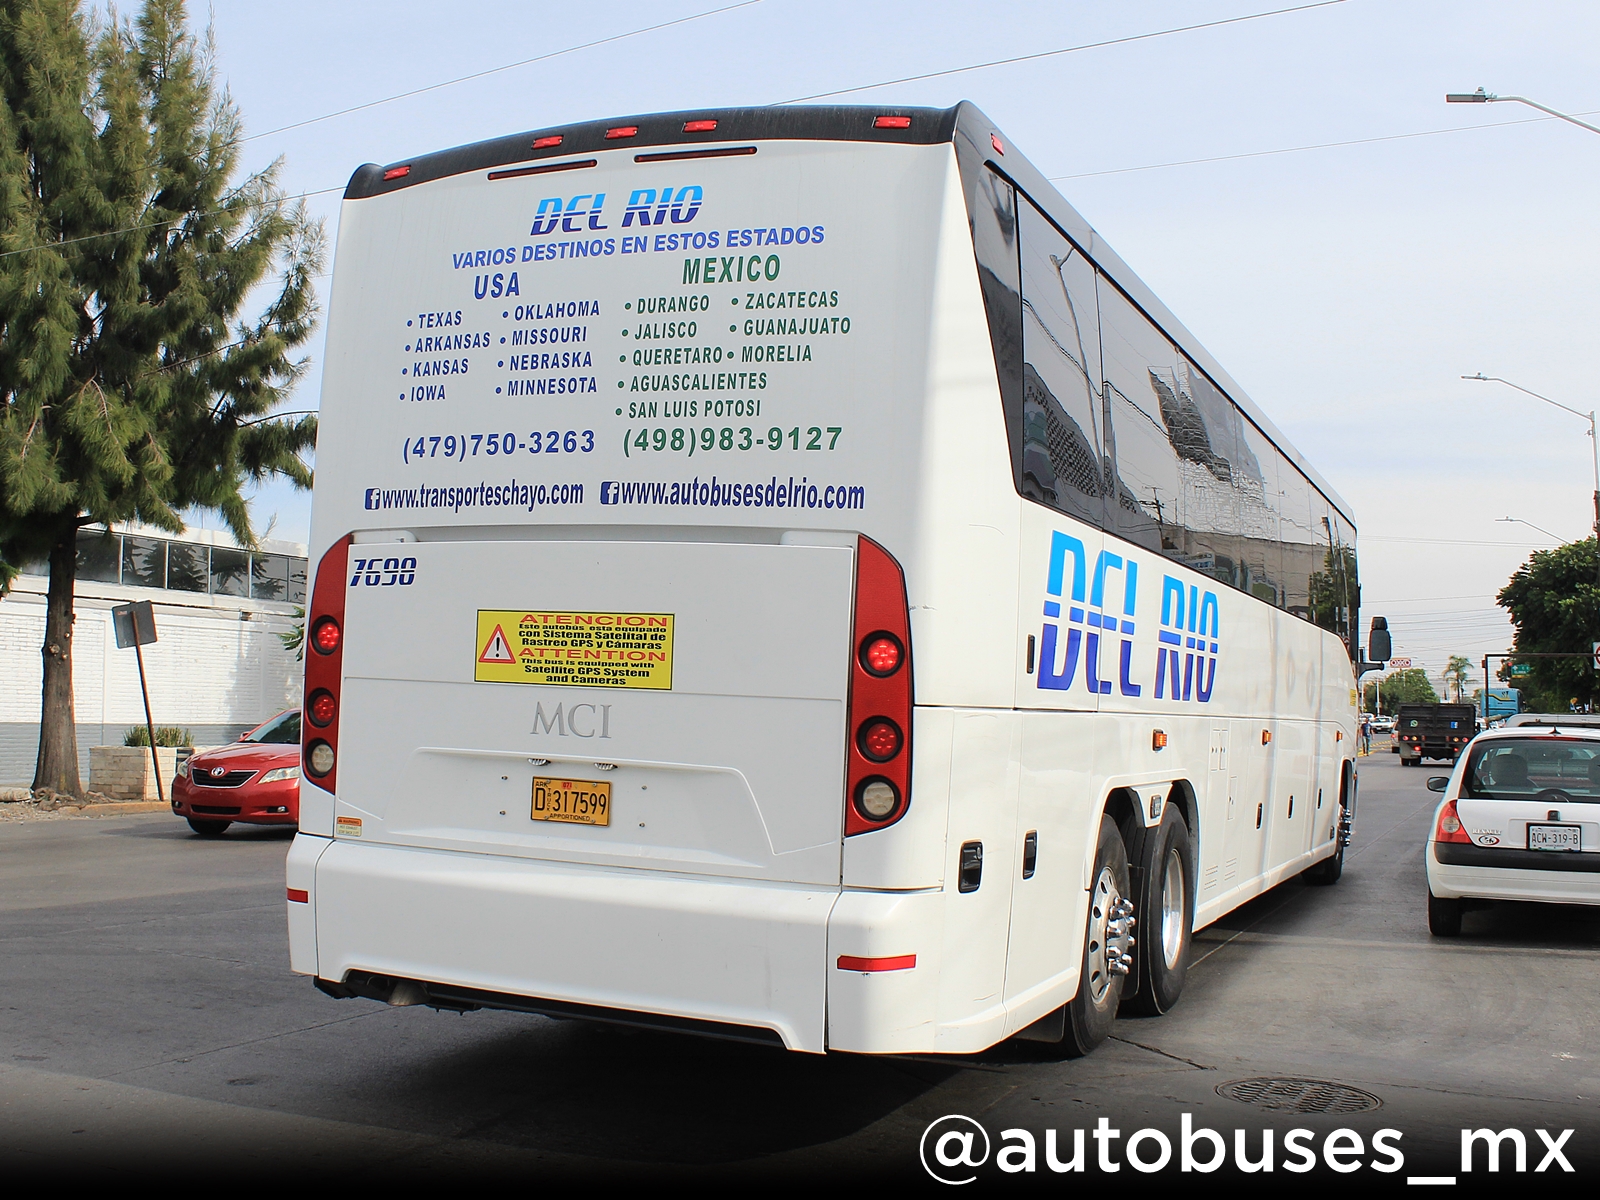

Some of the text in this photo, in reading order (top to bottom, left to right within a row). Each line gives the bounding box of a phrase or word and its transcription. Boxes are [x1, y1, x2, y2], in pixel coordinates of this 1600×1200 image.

[530, 185, 703, 236] DEL RIO
[452, 226, 825, 269] VARIOS DESTINOS EN ESTOS ESTADOS
[682, 254, 781, 284] MEXICO
[474, 271, 520, 300] USA
[514, 300, 600, 321] OKLAHOMA
[637, 295, 709, 314] DURANGO
[745, 291, 839, 310] ZACATECAS
[418, 310, 462, 329] TEXAS
[743, 317, 851, 336] GUANAJUATO
[512, 326, 587, 346] MISSOURI
[634, 321, 697, 340] JALISCO
[415, 332, 491, 353] ARKANSAS
[509, 351, 592, 371] NEBRASKA
[632, 347, 722, 366] QUERETARO
[741, 345, 812, 363] MORELIA
[413, 358, 469, 378] KANSAS
[507, 376, 597, 396] MINNESOTA
[630, 372, 767, 392] AGUASCALIENTES
[410, 384, 446, 402] IOWA
[628, 399, 761, 419] SAN LUIS POTOSI
[403, 429, 595, 464] (479)750-3263
[623, 426, 842, 458] (498)983-9127
[382, 478, 584, 513] www.transporteschayo.com
[621, 476, 865, 509] www.autobusesdelrio.com
[520, 614, 667, 627] ATENCION
[1036, 529, 1219, 703] DEL RIO
[519, 630, 666, 641] con Sistema Satelital de
[522, 638, 662, 650] Rastreo GPS y Cámaras
[518, 648, 666, 662] ATTENTION
[521, 657, 543, 665] This
[577, 660, 628, 668] equipped
[524, 665, 650, 678] Satellite GPS System
[546, 675, 626, 685] and Cameras
[530, 701, 612, 739] MCI
[552, 790, 607, 815] 317599
[549, 813, 591, 822] APPORTIONED
